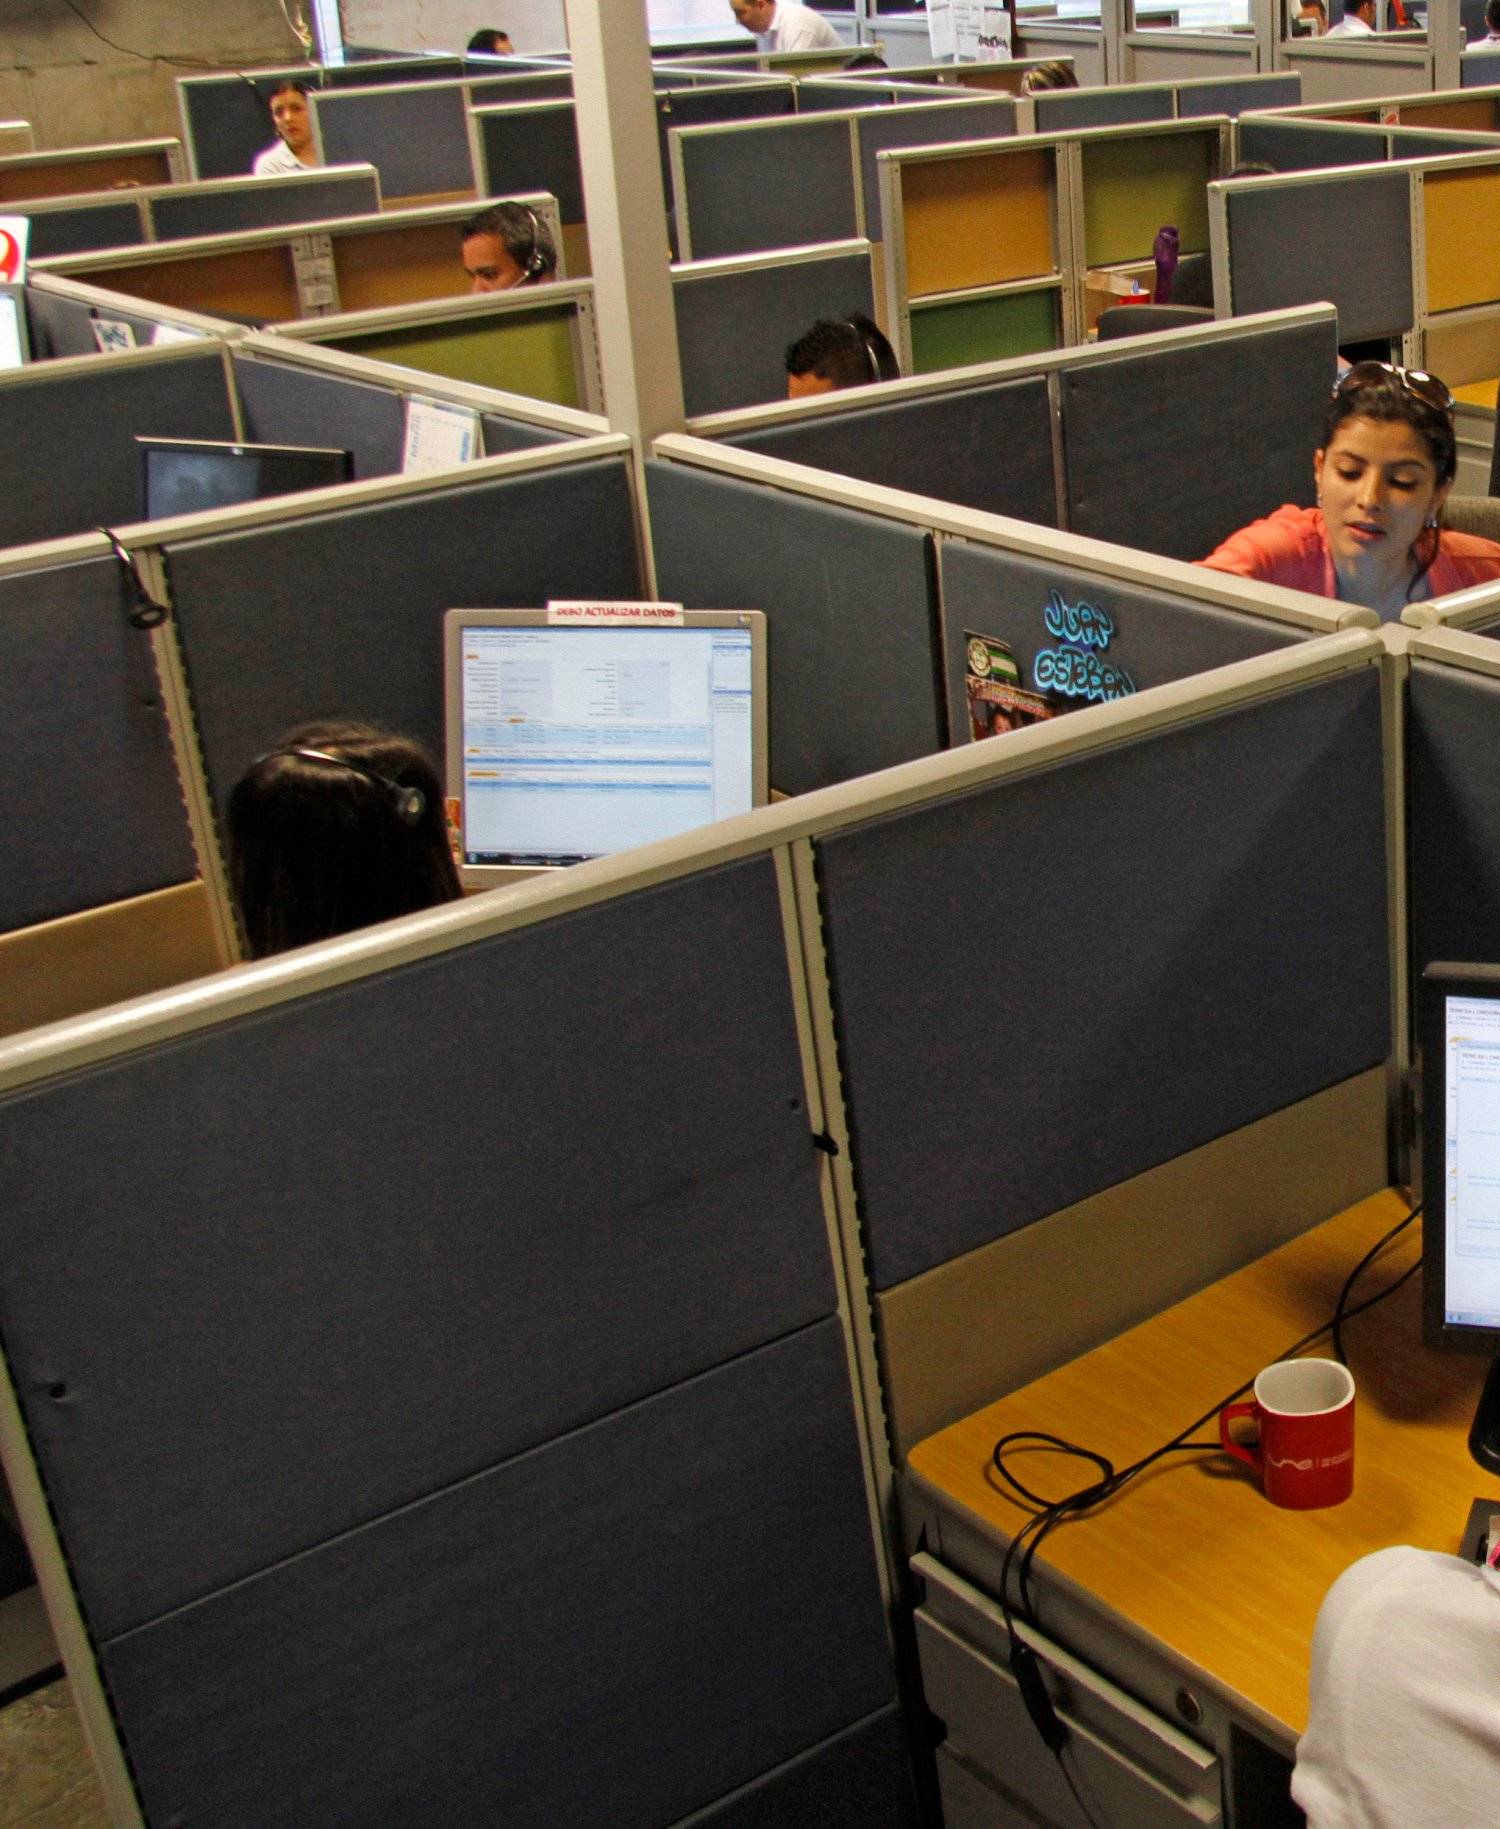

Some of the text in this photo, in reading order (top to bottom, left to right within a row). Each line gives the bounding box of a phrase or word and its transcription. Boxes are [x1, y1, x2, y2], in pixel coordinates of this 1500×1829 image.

[556, 607, 677, 618] DEBO ACTUALIZAR DATOS
